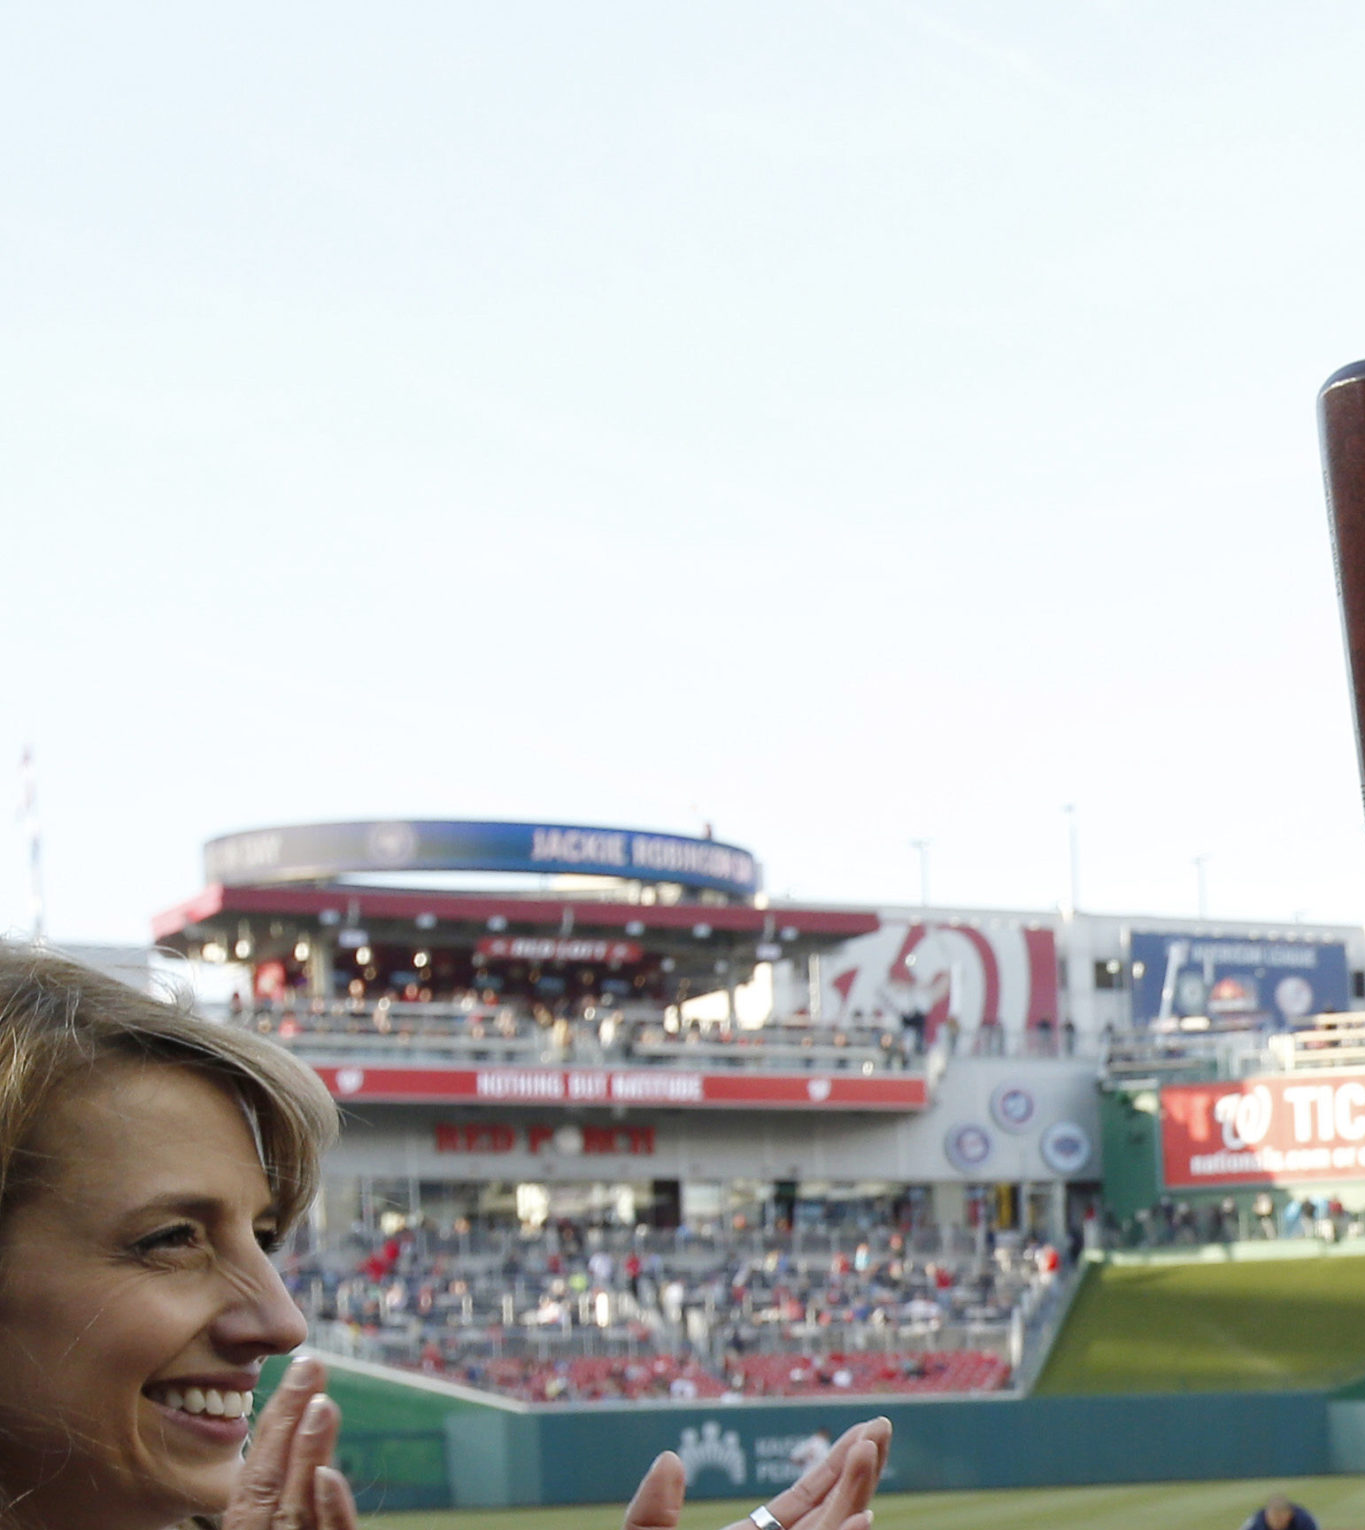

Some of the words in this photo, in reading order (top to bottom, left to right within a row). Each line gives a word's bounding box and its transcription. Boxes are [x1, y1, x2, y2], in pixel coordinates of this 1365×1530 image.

[531, 827, 627, 866] JACKIE
[477, 1071, 564, 1097] NOTHING
[568, 1072, 607, 1099] BUT
[435, 1122, 515, 1154] RED
